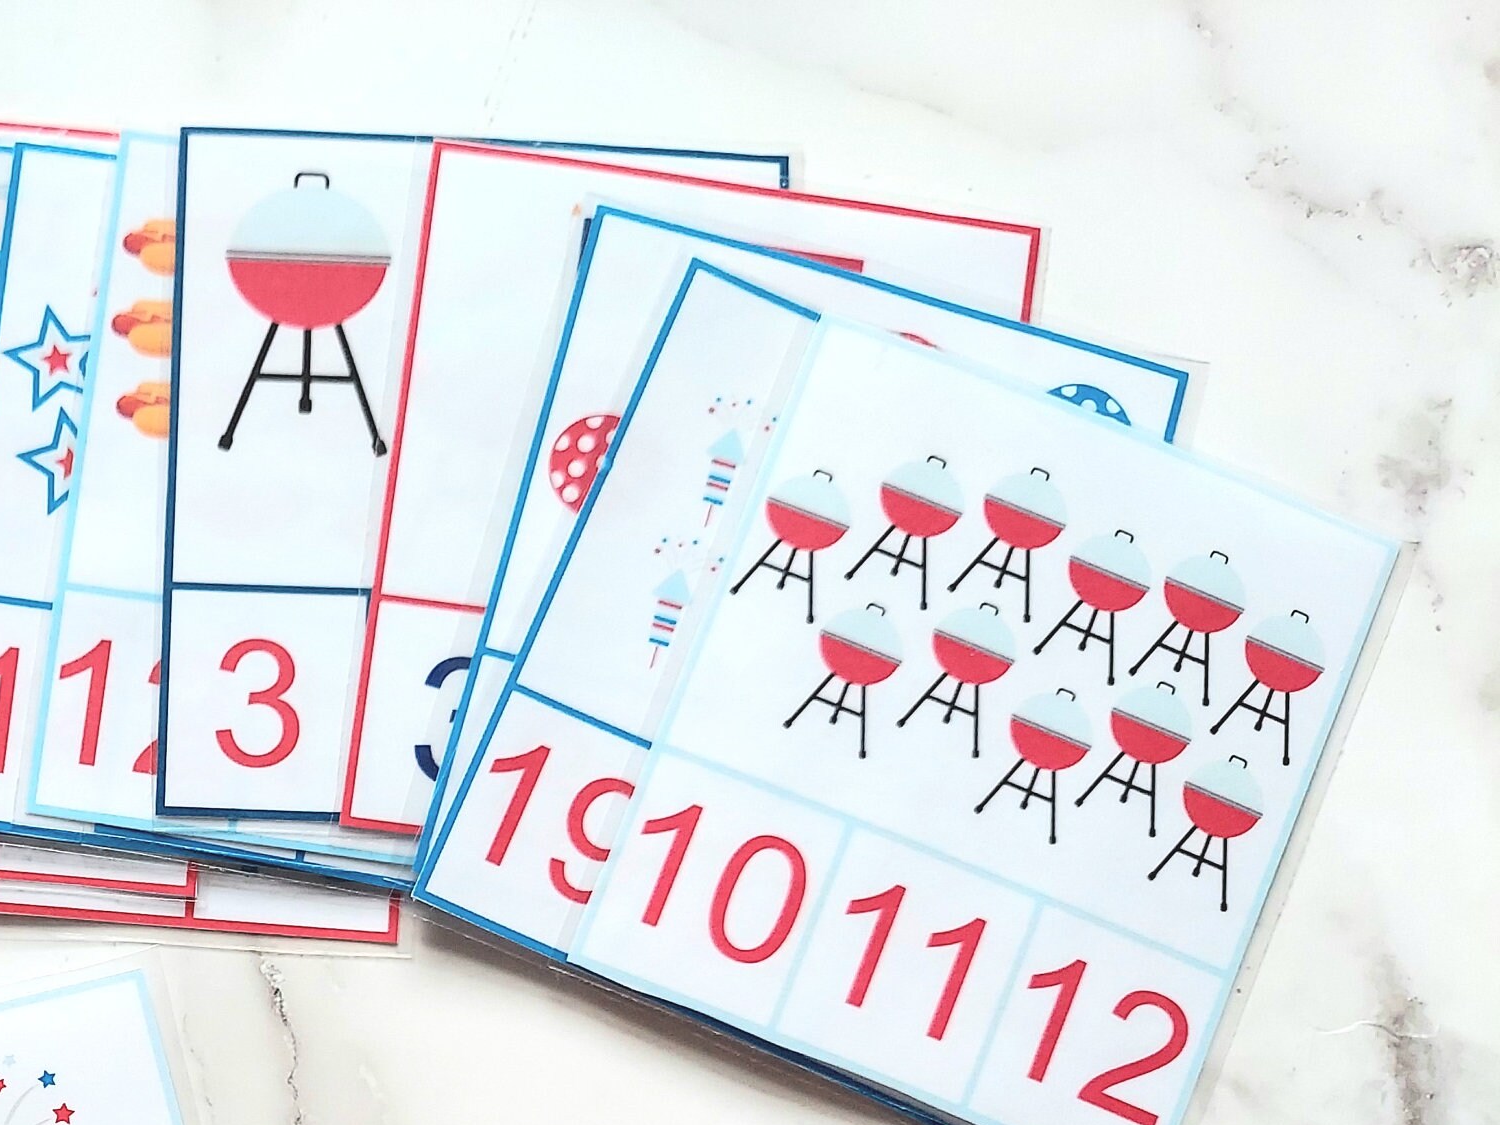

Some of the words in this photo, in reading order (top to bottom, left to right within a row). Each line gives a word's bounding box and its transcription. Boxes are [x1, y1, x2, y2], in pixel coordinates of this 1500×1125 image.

[215, 638, 300, 768] 3
[641, 804, 807, 964] 10
[845, 883, 987, 1042] 11
